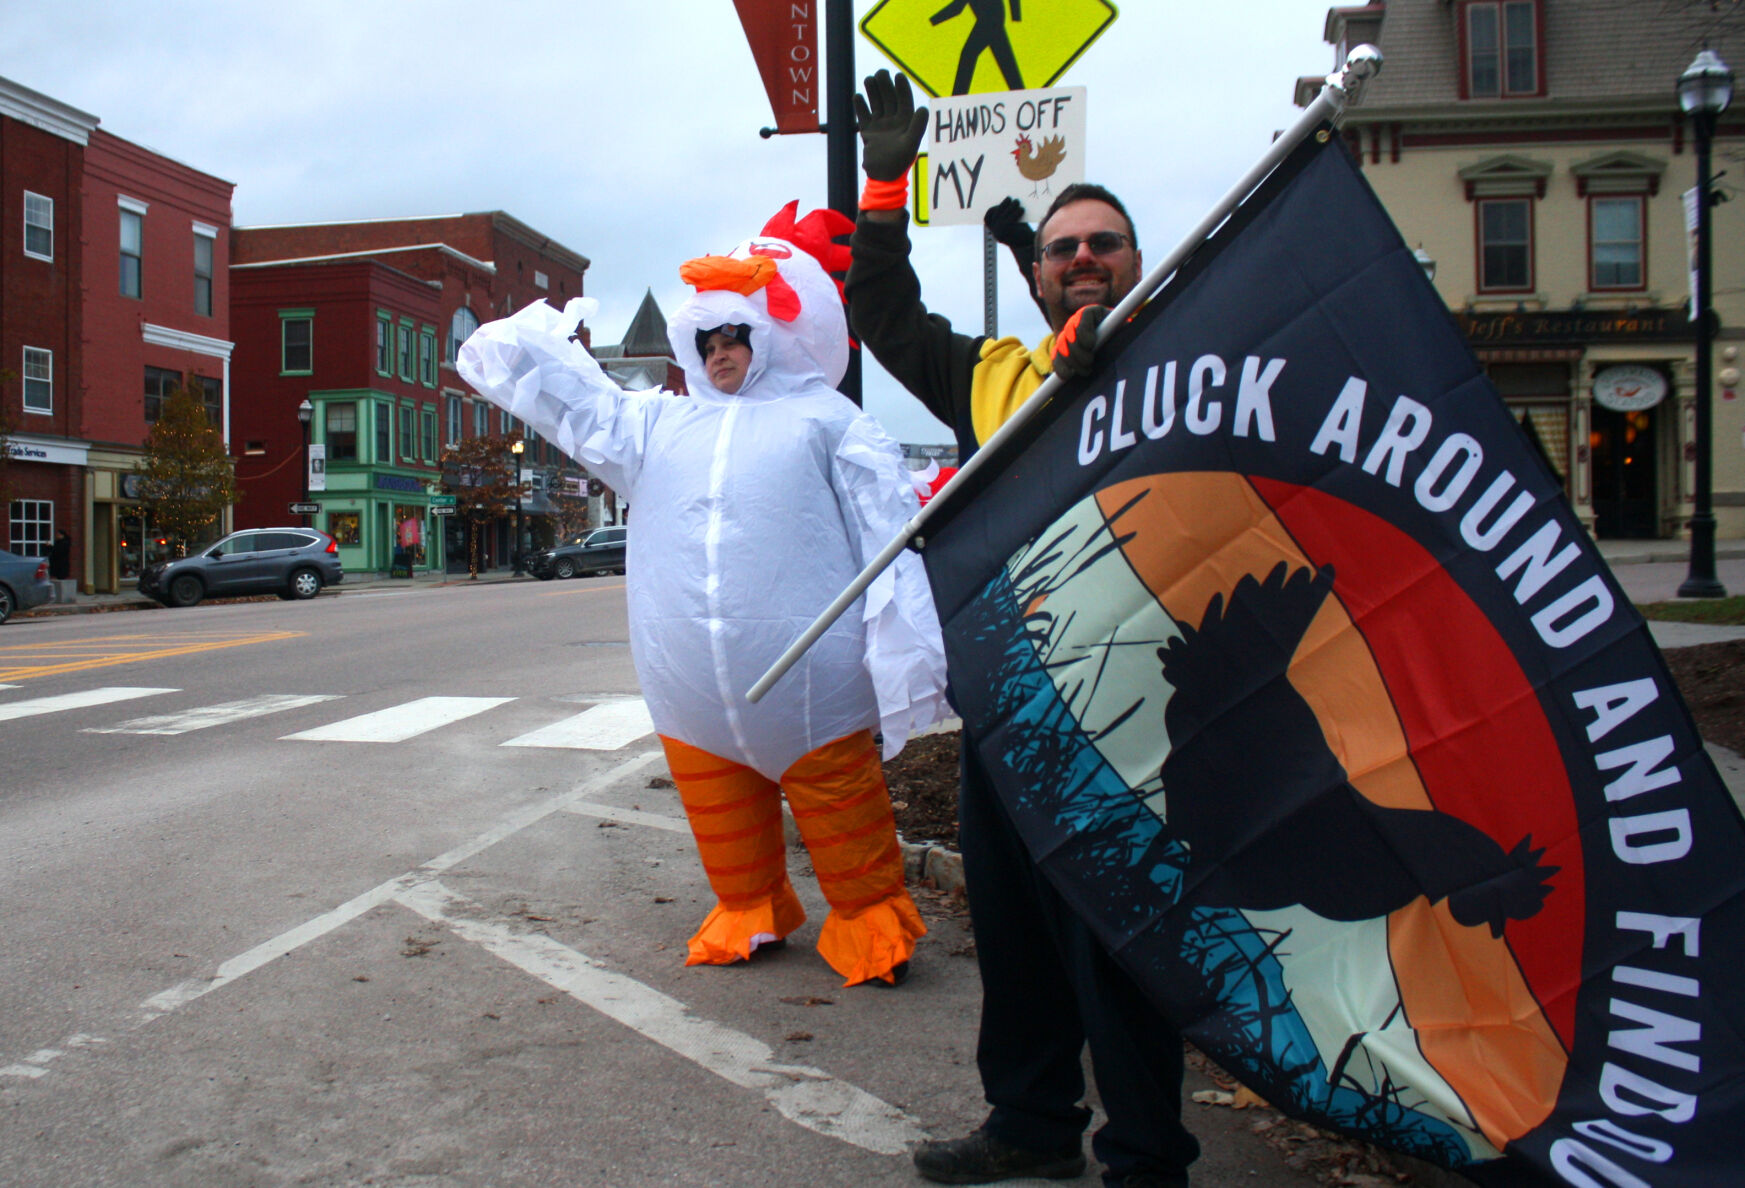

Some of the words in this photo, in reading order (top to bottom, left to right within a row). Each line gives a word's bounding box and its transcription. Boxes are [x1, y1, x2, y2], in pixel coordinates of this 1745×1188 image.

[935, 102, 1006, 143] HANDS
[1016, 96, 1072, 131] OFF
[933, 154, 984, 209] MY
[1535, 317, 1666, 334] Restaurant
[1077, 353, 1287, 466] CLUCK
[1310, 376, 1614, 648] AROUND
[1573, 677, 1692, 864] AND
[1599, 911, 1701, 1123] FIND
